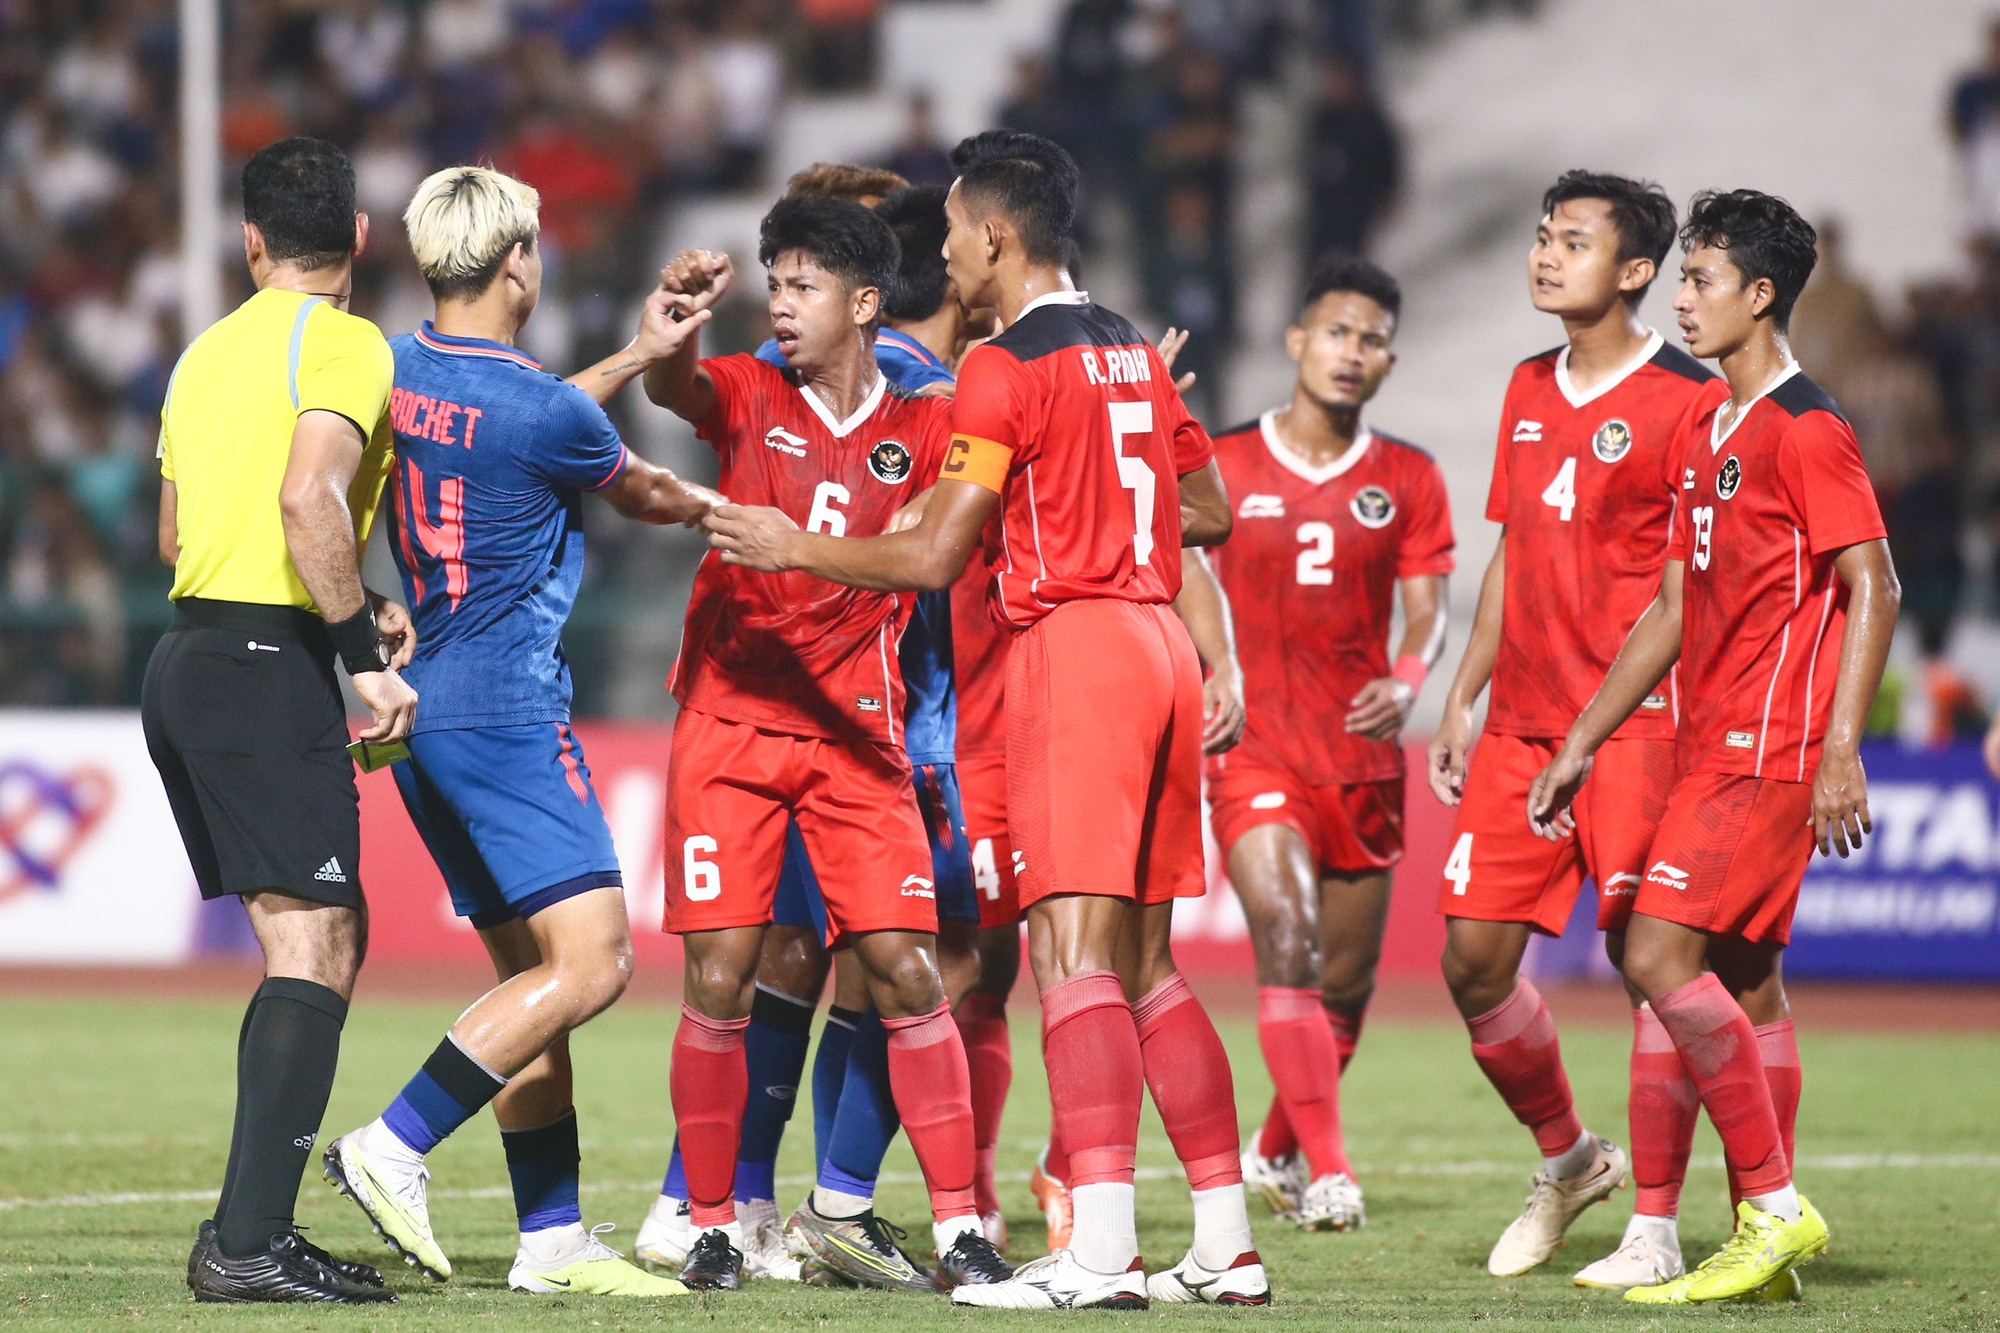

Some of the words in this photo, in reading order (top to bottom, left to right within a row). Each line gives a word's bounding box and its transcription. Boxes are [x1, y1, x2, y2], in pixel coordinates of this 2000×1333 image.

[944, 439, 970, 473] C
[1107, 401, 1156, 566] 5
[806, 480, 851, 538] 6
[1541, 456, 1577, 522] 4
[391, 452, 470, 614] 14
[1296, 521, 1335, 585] 2
[1692, 506, 1714, 571] 13
[314, 871, 347, 883] adidas
[683, 834, 721, 902] 6
[972, 837, 1001, 901] 4
[1443, 832, 1474, 896] 4
[1647, 873, 1688, 891] LI-NING
[206, 1260, 226, 1276] COPA
